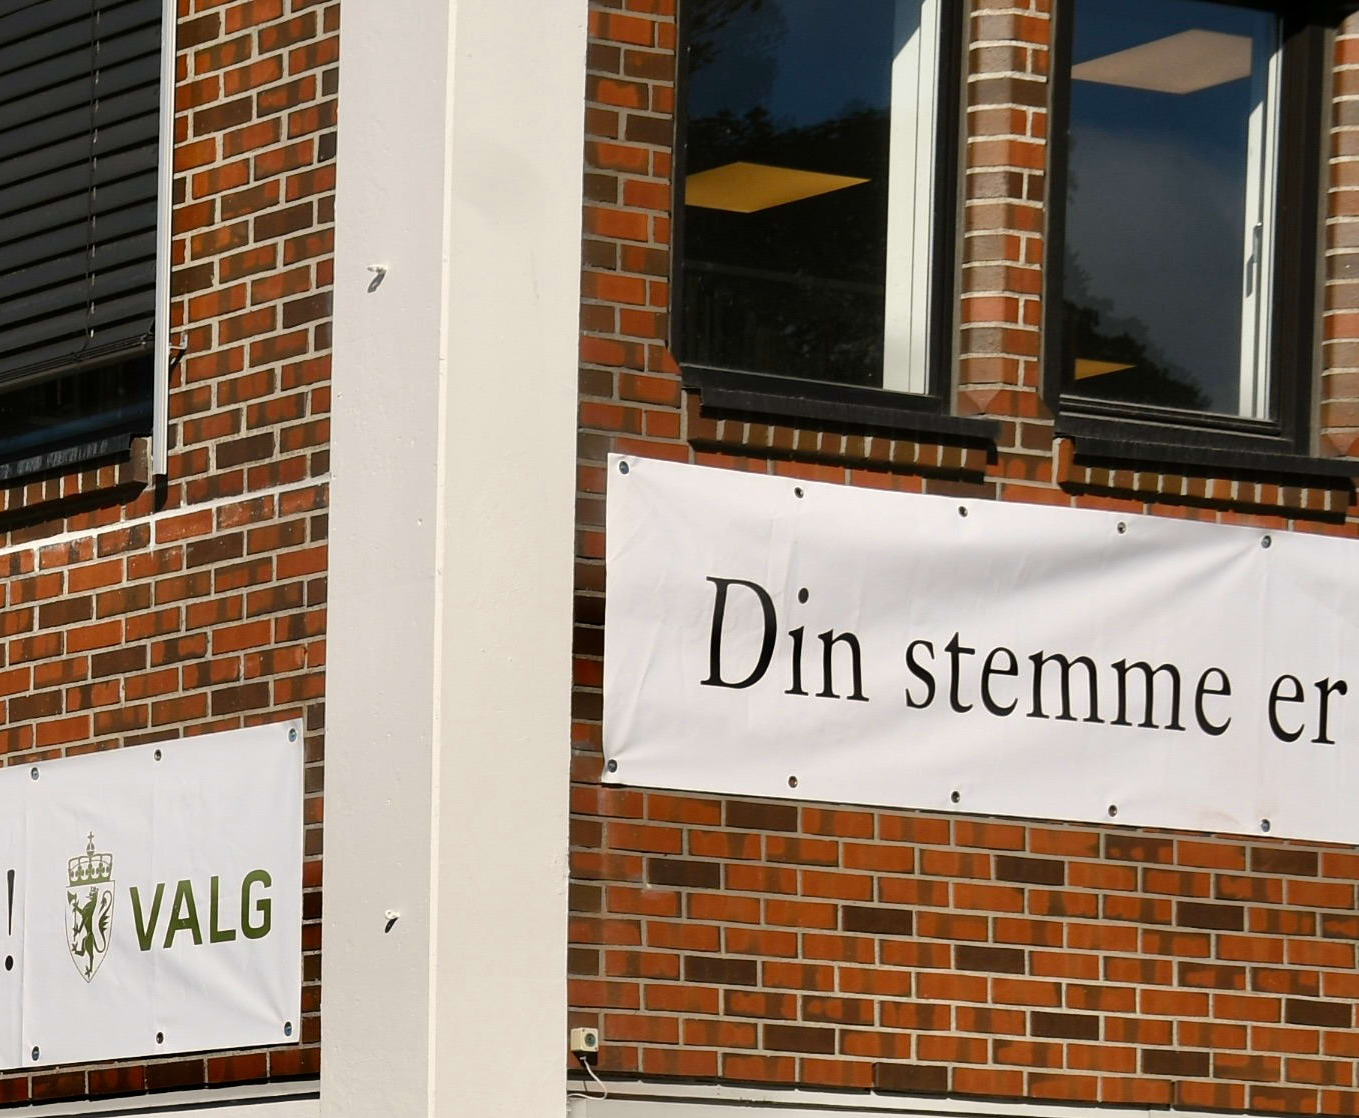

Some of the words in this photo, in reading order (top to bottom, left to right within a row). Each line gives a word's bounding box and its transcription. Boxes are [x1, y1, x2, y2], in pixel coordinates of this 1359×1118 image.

[701, 576, 869, 702] Din
[905, 632, 1232, 736] stemme
[1268, 672, 1347, 745] er
[130, 869, 273, 952] VALG
